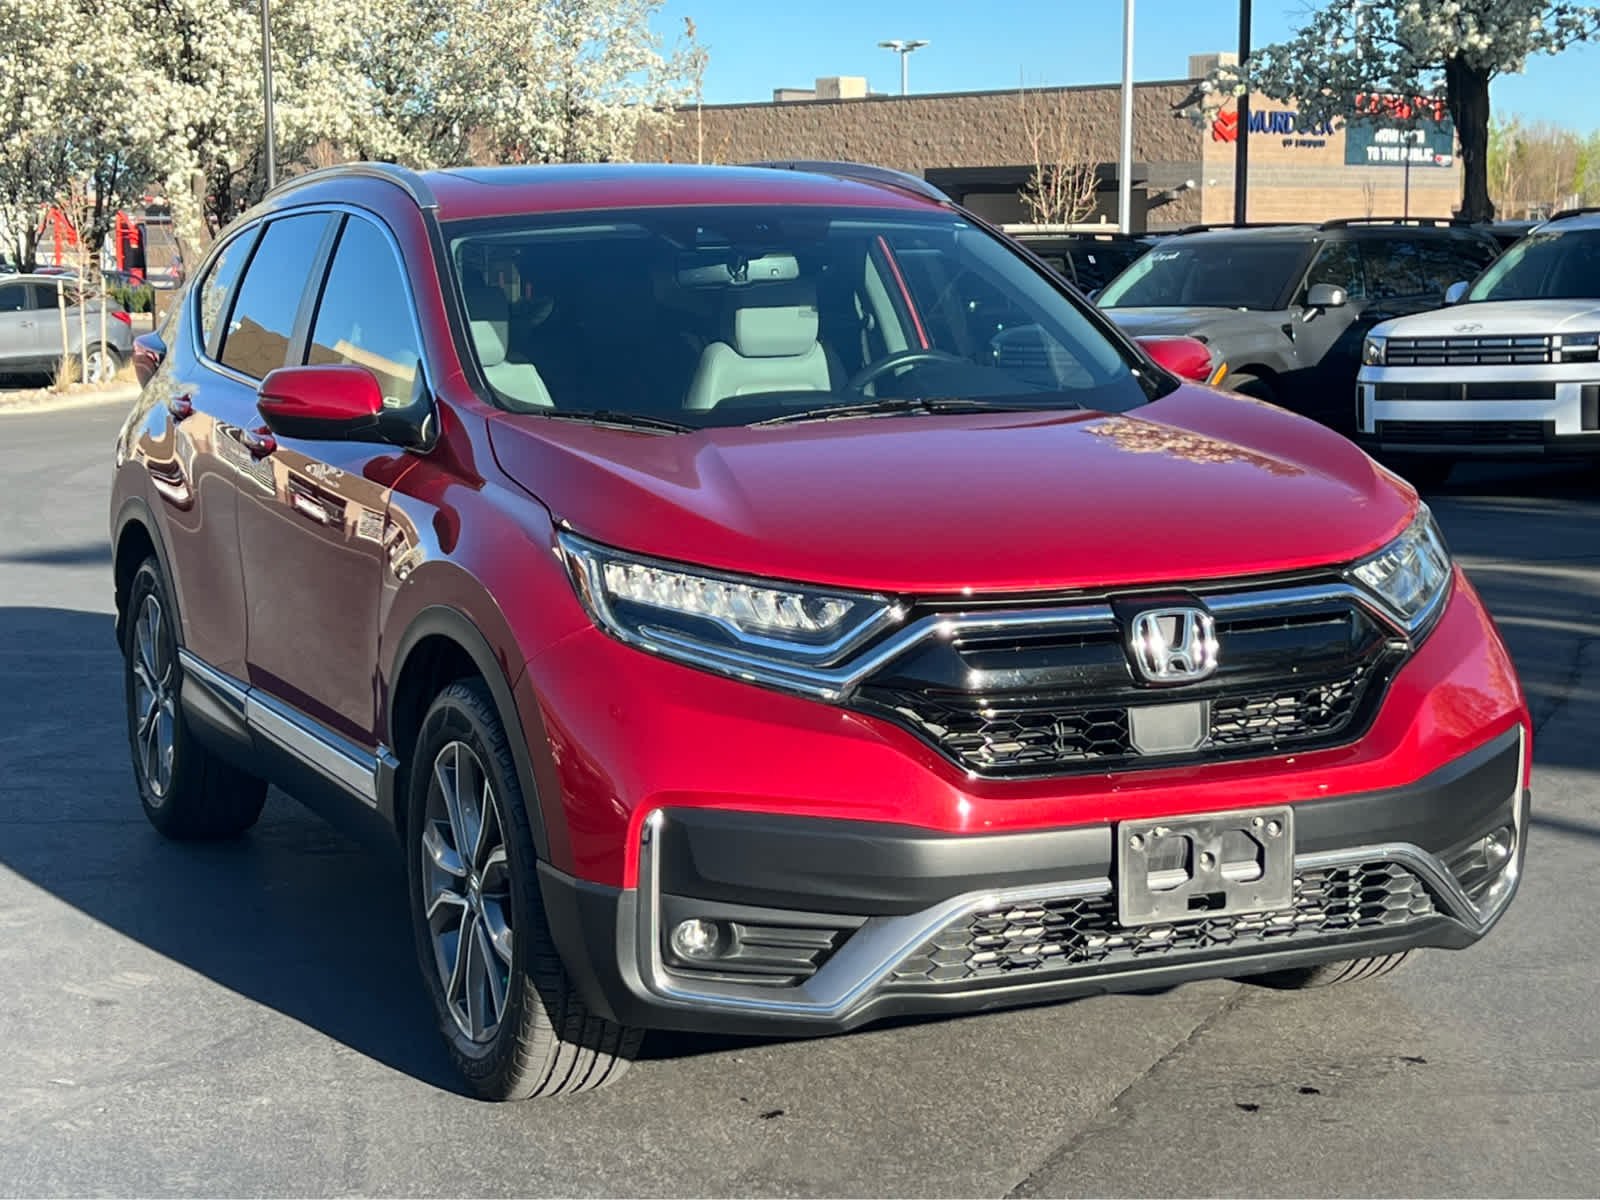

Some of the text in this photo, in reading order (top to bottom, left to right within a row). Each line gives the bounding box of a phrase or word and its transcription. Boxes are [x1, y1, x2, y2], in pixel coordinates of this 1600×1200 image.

[1248, 112, 1334, 136] MURDK
[1367, 146, 1379, 161] TO
[1381, 146, 1400, 161] THE
